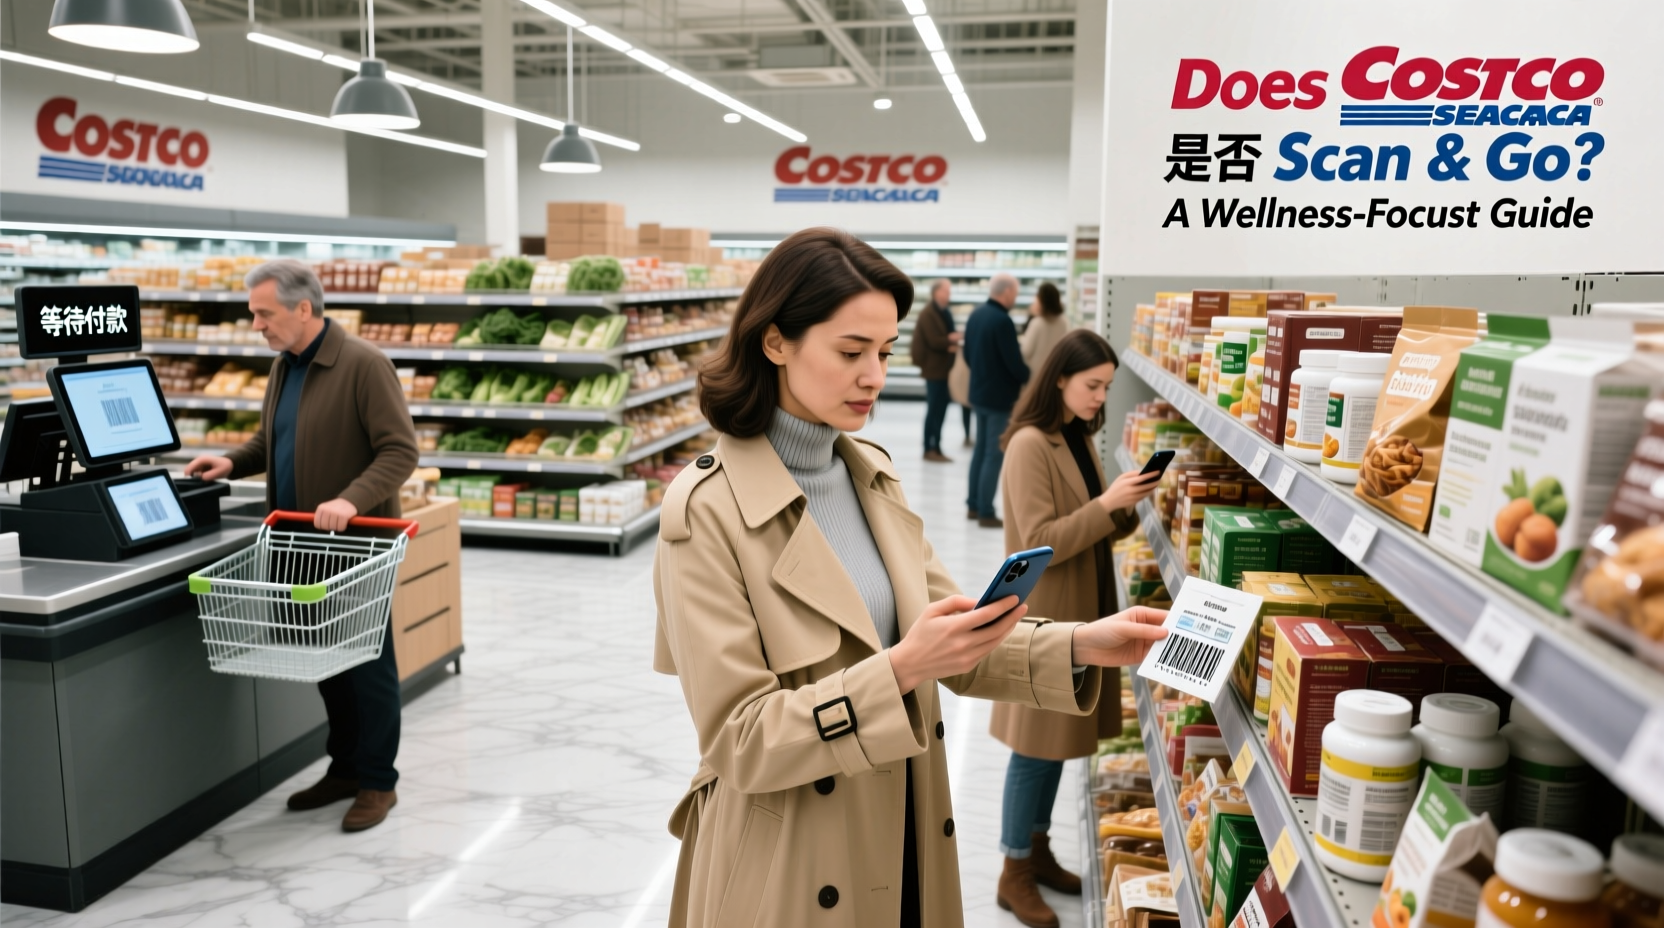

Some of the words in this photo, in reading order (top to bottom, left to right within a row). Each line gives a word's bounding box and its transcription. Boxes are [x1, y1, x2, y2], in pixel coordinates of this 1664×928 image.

[1171, 58, 1329, 110] Does
[1341, 45, 1605, 101] COSTCO
[36, 96, 209, 168] COSTCO
[774, 145, 948, 185] COSTCO
[1164, 133, 1262, 183] 是否
[1273, 132, 1411, 182] Scan
[1427, 132, 1471, 182] &
[1486, 131, 1605, 182] Go?
[1162, 198, 1190, 228] A
[1201, 196, 1481, 229] Wellness-Focust
[1490, 196, 1594, 229] Guide
[40, 304, 128, 337] 等待付款
